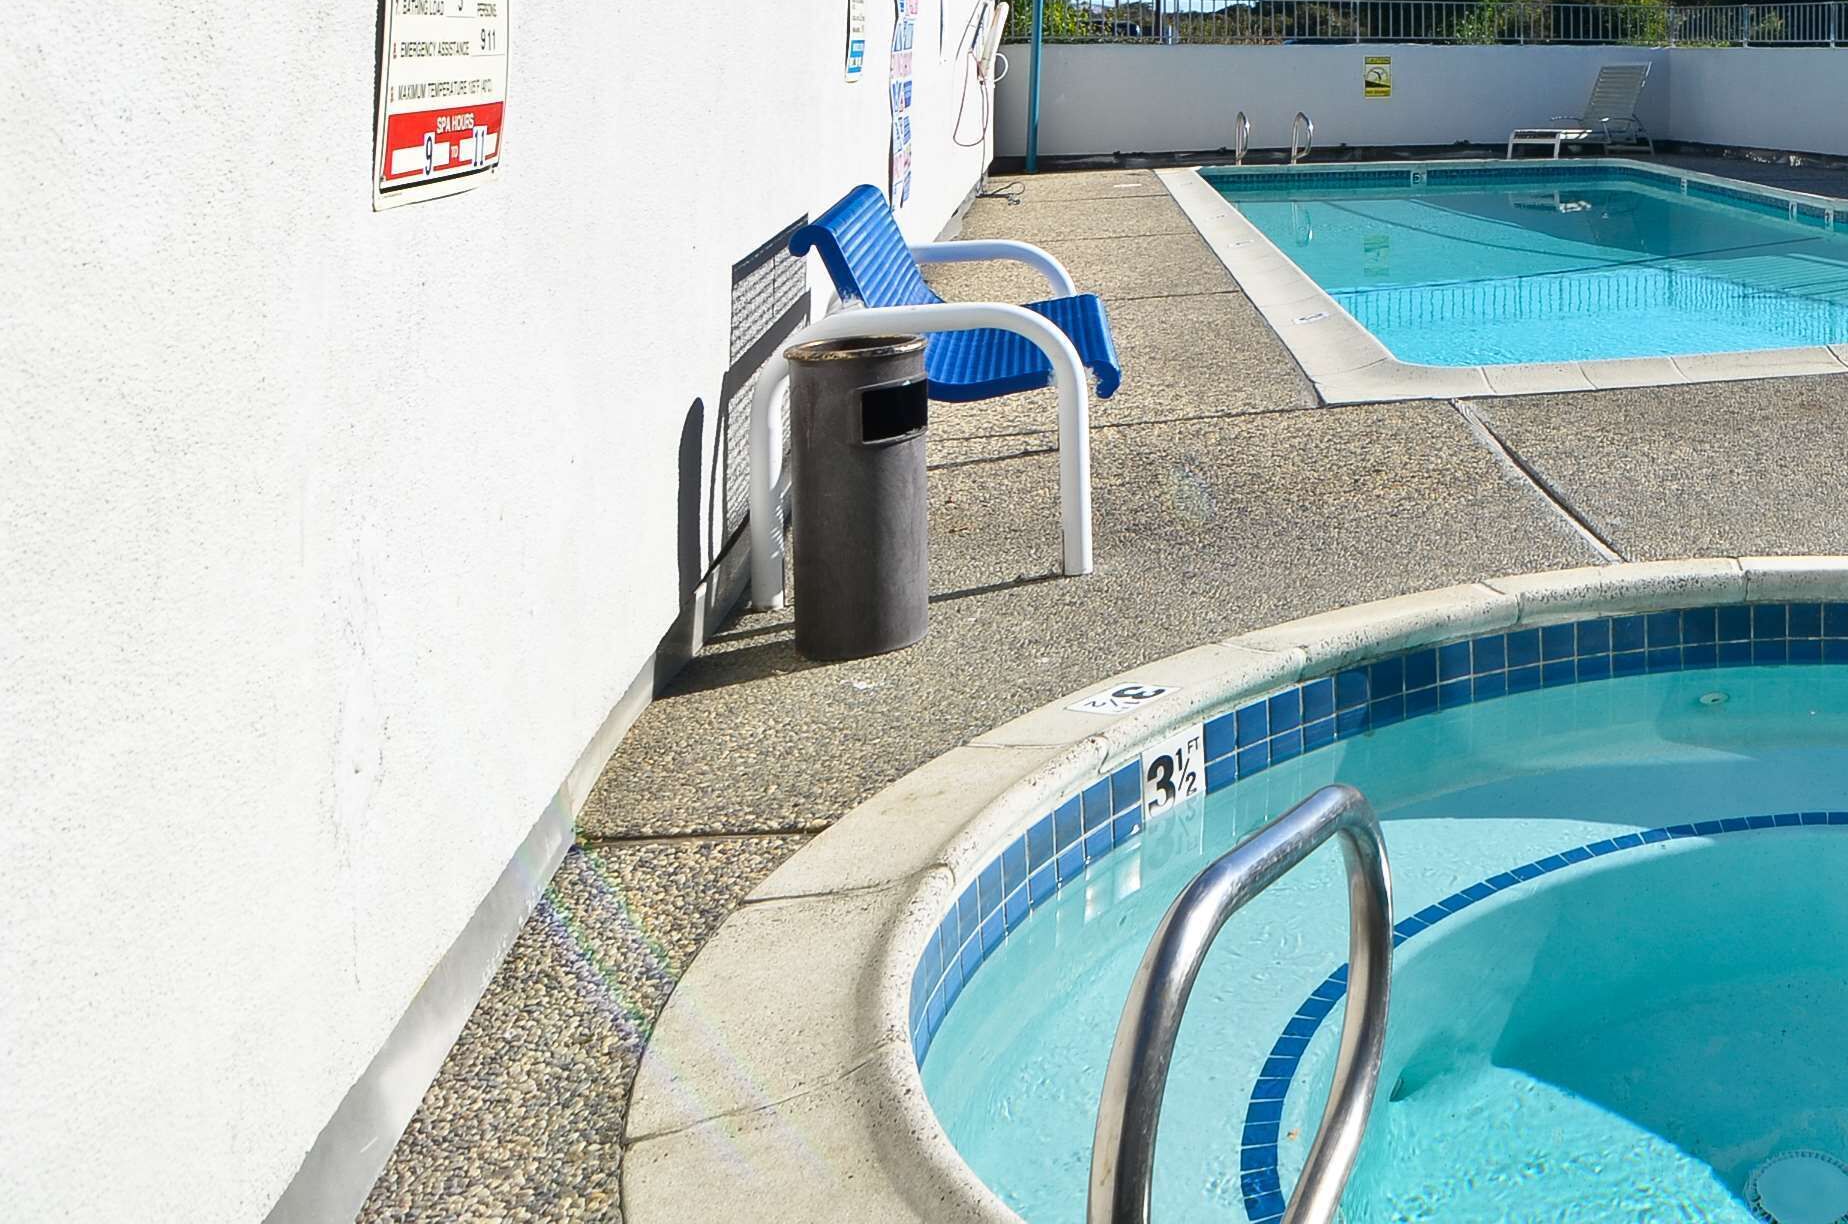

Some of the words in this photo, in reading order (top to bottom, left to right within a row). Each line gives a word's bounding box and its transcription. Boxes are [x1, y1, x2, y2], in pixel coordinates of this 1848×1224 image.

[429, 0, 445, 16] LOAD
[477, 2, 497, 18] PERSONS
[400, 41, 437, 58] EMERGENCY
[437, 41, 470, 57] ASSISTANCE
[480, 28, 496, 51] 911
[398, 83, 426, 101] MAXIMUM
[427, 80, 467, 98] TEMPERATURE
[437, 115, 452, 135] SPA
[452, 112, 475, 132] HOURS
[425, 136, 434, 176] 9
[473, 129, 485, 167] 11
[1187, 736, 1199, 754] FT
